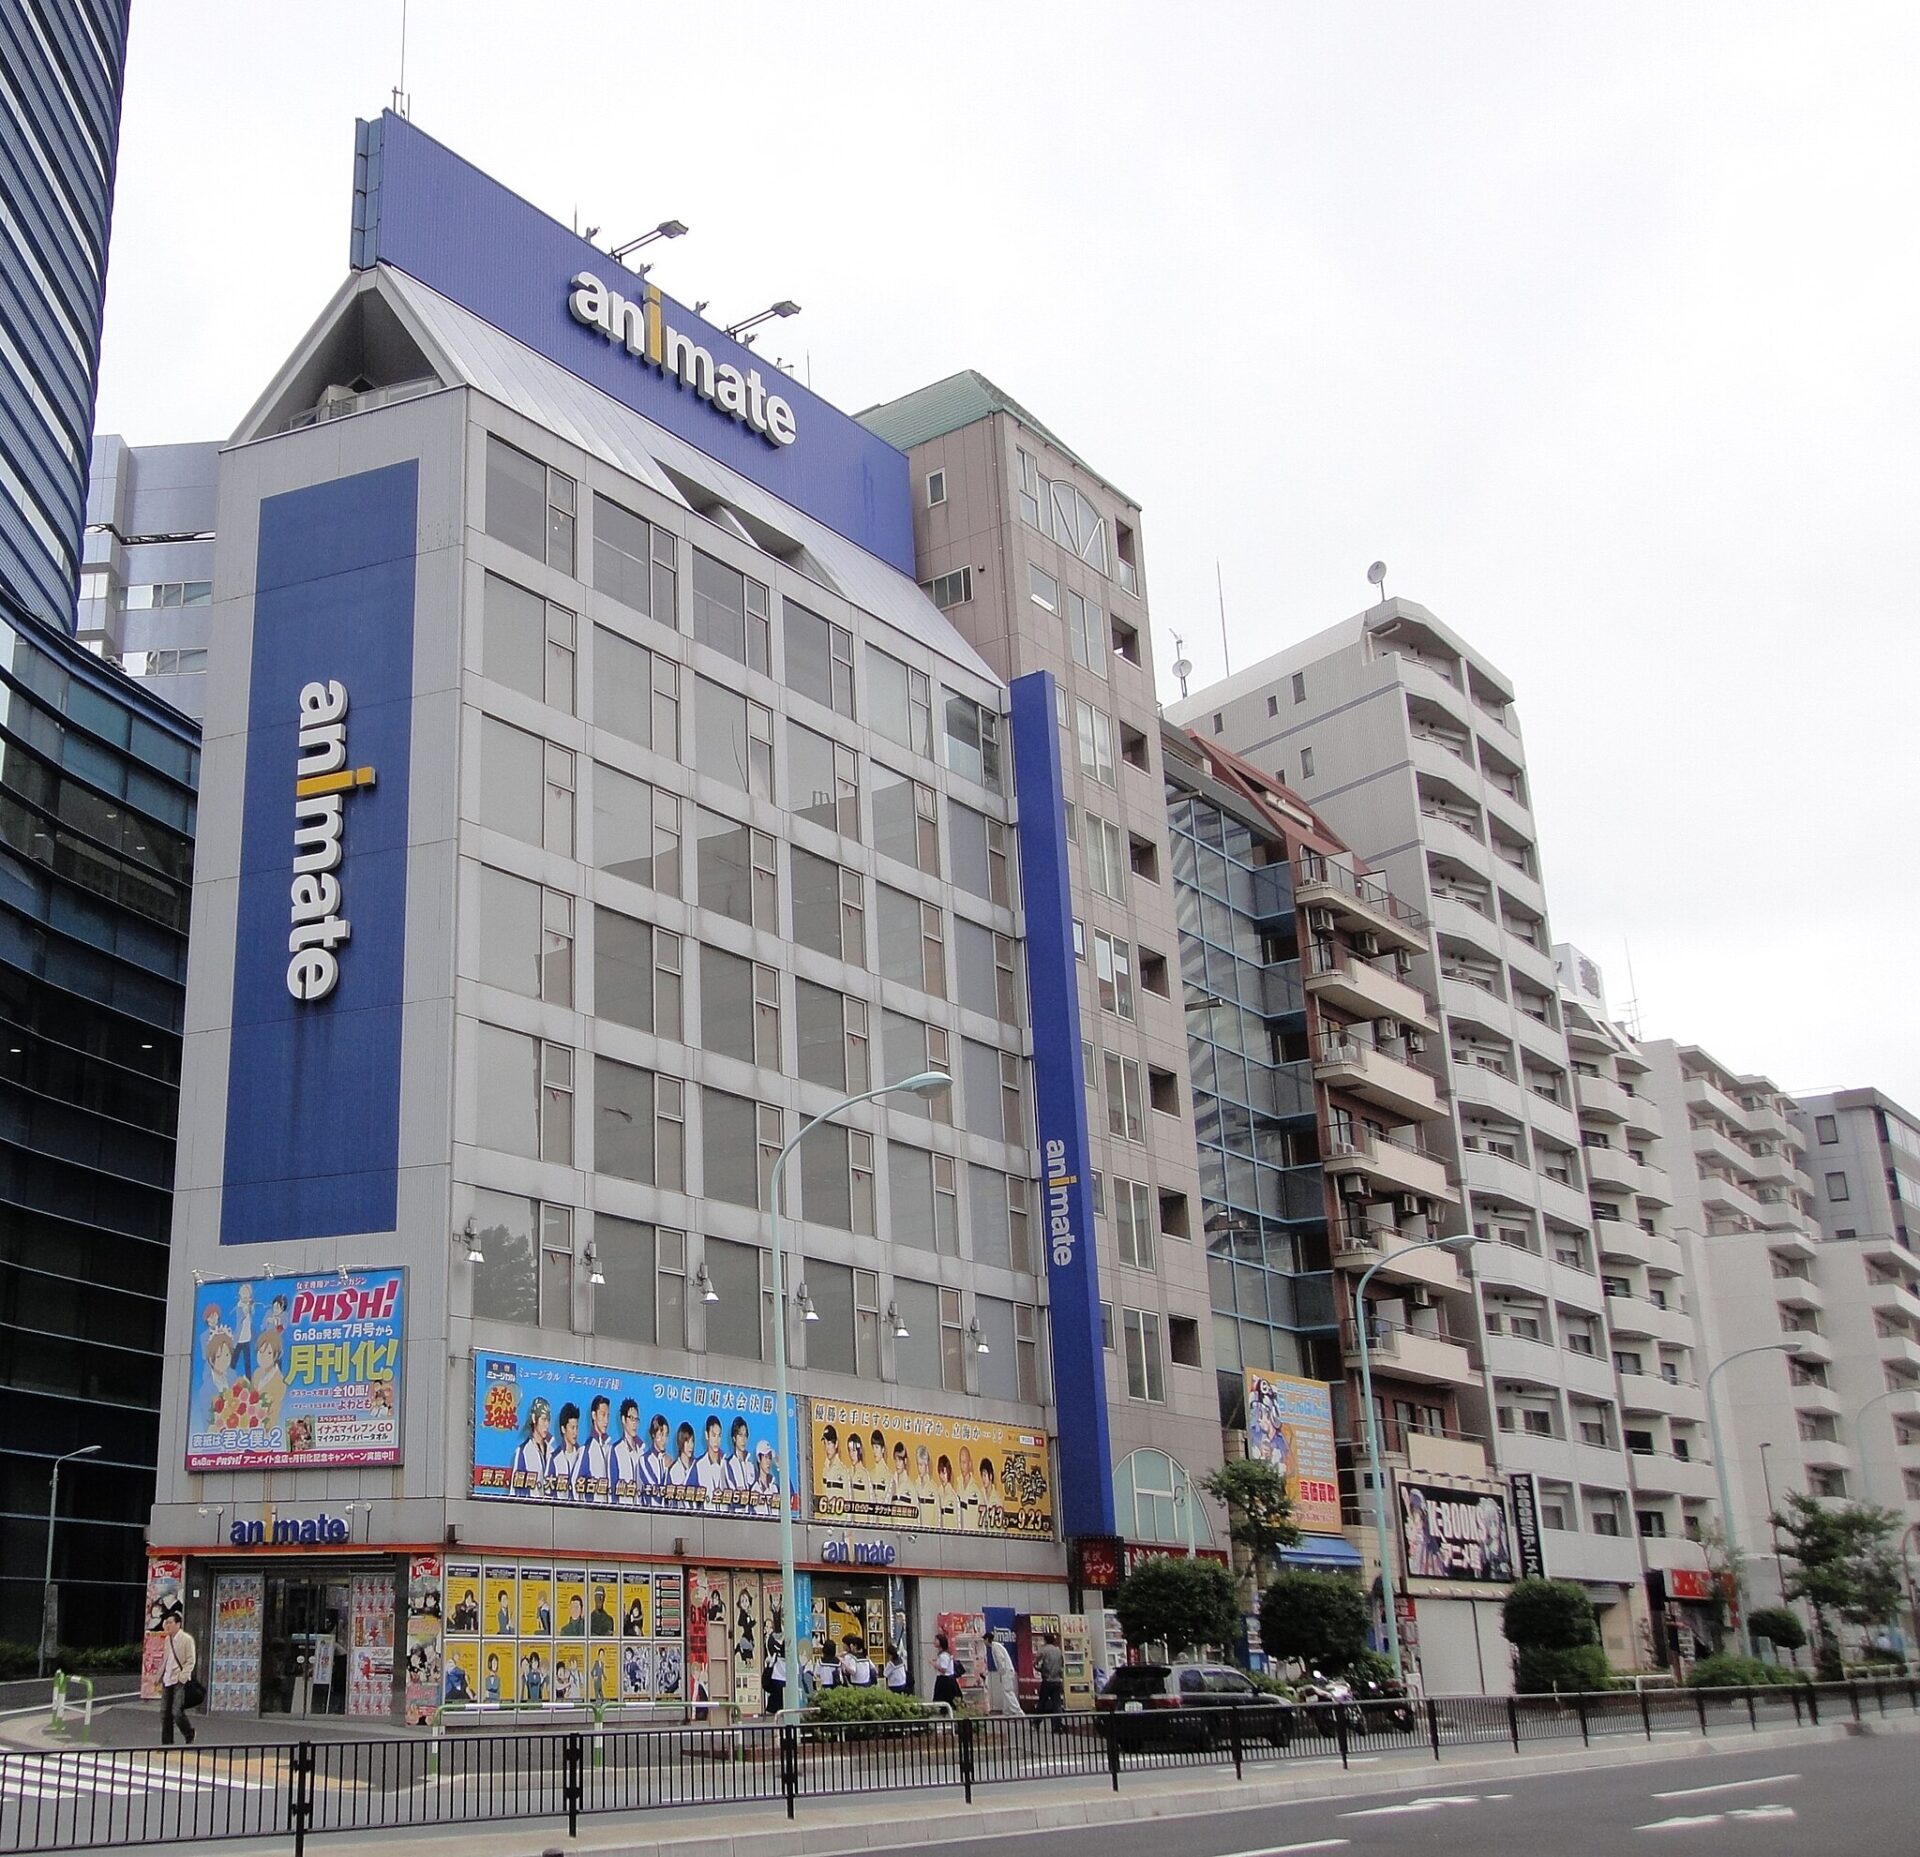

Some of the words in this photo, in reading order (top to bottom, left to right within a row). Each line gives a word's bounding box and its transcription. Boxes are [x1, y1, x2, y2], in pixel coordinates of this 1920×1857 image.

[569, 271, 796, 446] animate
[287, 680, 376, 1000] animate
[1046, 1139, 1077, 1267] animate
[291, 1279, 399, 1324] PASH!
[230, 1507, 350, 1545] animate
[822, 1531, 896, 1566] animate
